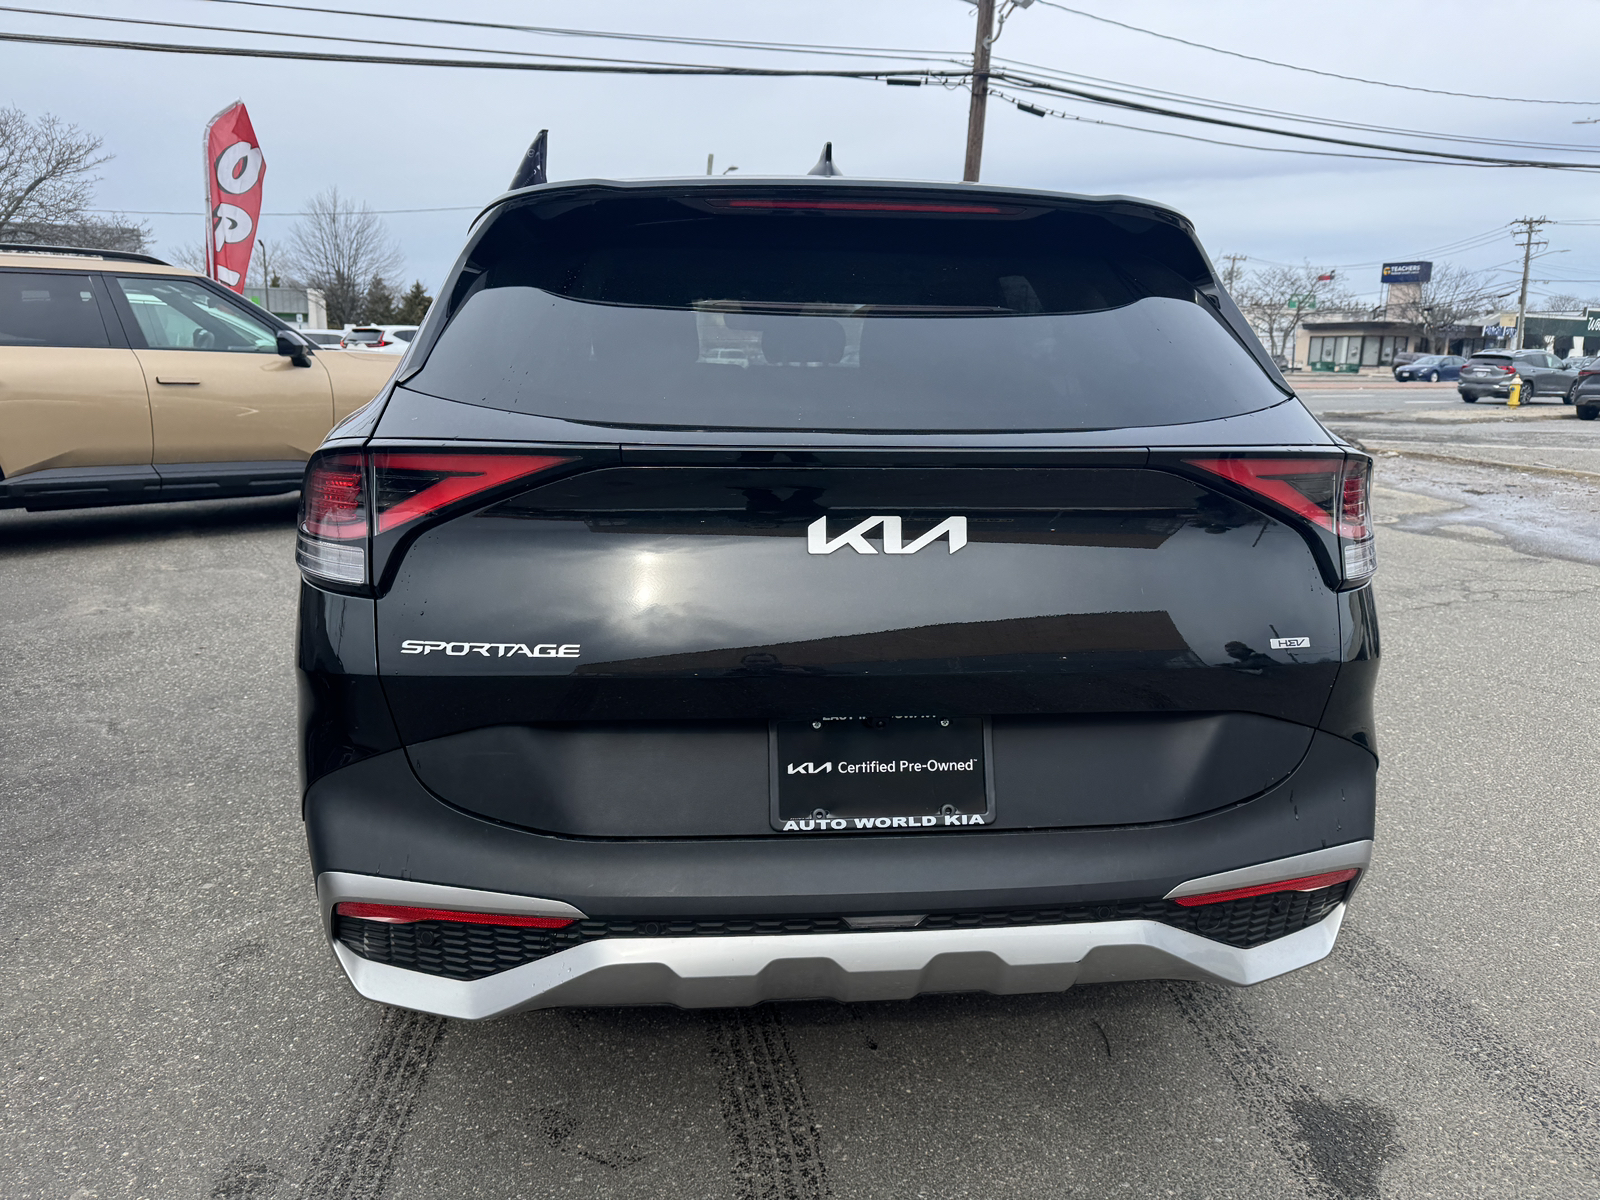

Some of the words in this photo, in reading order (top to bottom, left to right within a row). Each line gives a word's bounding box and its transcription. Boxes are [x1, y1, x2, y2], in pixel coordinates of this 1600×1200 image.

[213, 141, 263, 287] OP
[808, 515, 967, 555] KIA
[400, 639, 581, 658] SPORTAGE
[1278, 638, 1305, 648] HEV
[787, 762, 832, 774] KIA
[837, 760, 896, 774] Certified
[782, 818, 847, 831] AUTO
[853, 815, 937, 829] WORLD
[944, 814, 985, 826] KIA
